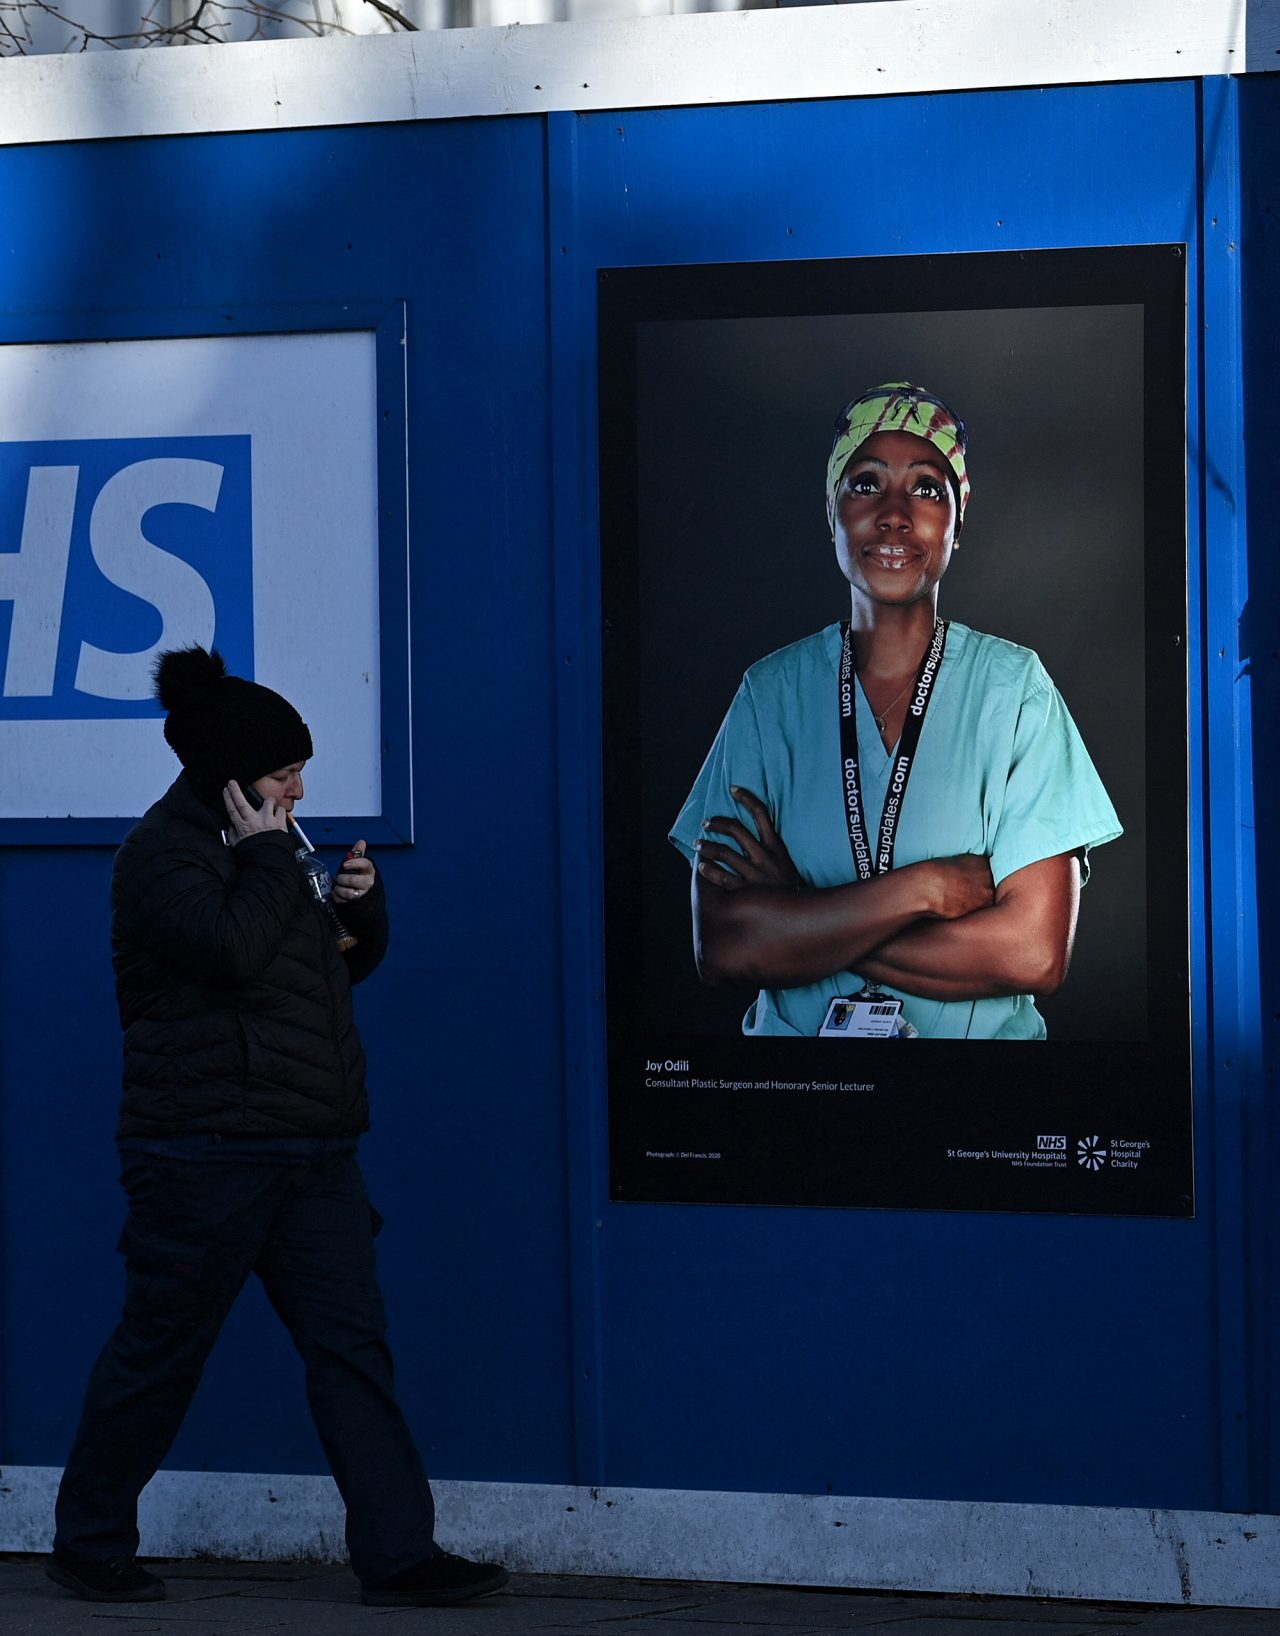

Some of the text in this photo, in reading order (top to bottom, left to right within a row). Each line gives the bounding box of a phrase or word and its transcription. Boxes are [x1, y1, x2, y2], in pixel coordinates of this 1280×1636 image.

[645, 1060, 689, 1073] Joy Odili
[645, 1078, 875, 1092] Consultant Plastic Surgeon and Honorary Senior Lecturer
[1038, 1137, 1065, 1149] NHS
[1110, 1140, 1150, 1149] St George's
[947, 1149, 1067, 1161] St George's University Hospitals
[1110, 1149, 1141, 1159] Hospital
[1024, 1160, 1053, 1168] Foundation
[1110, 1159, 1138, 1169] Charity
